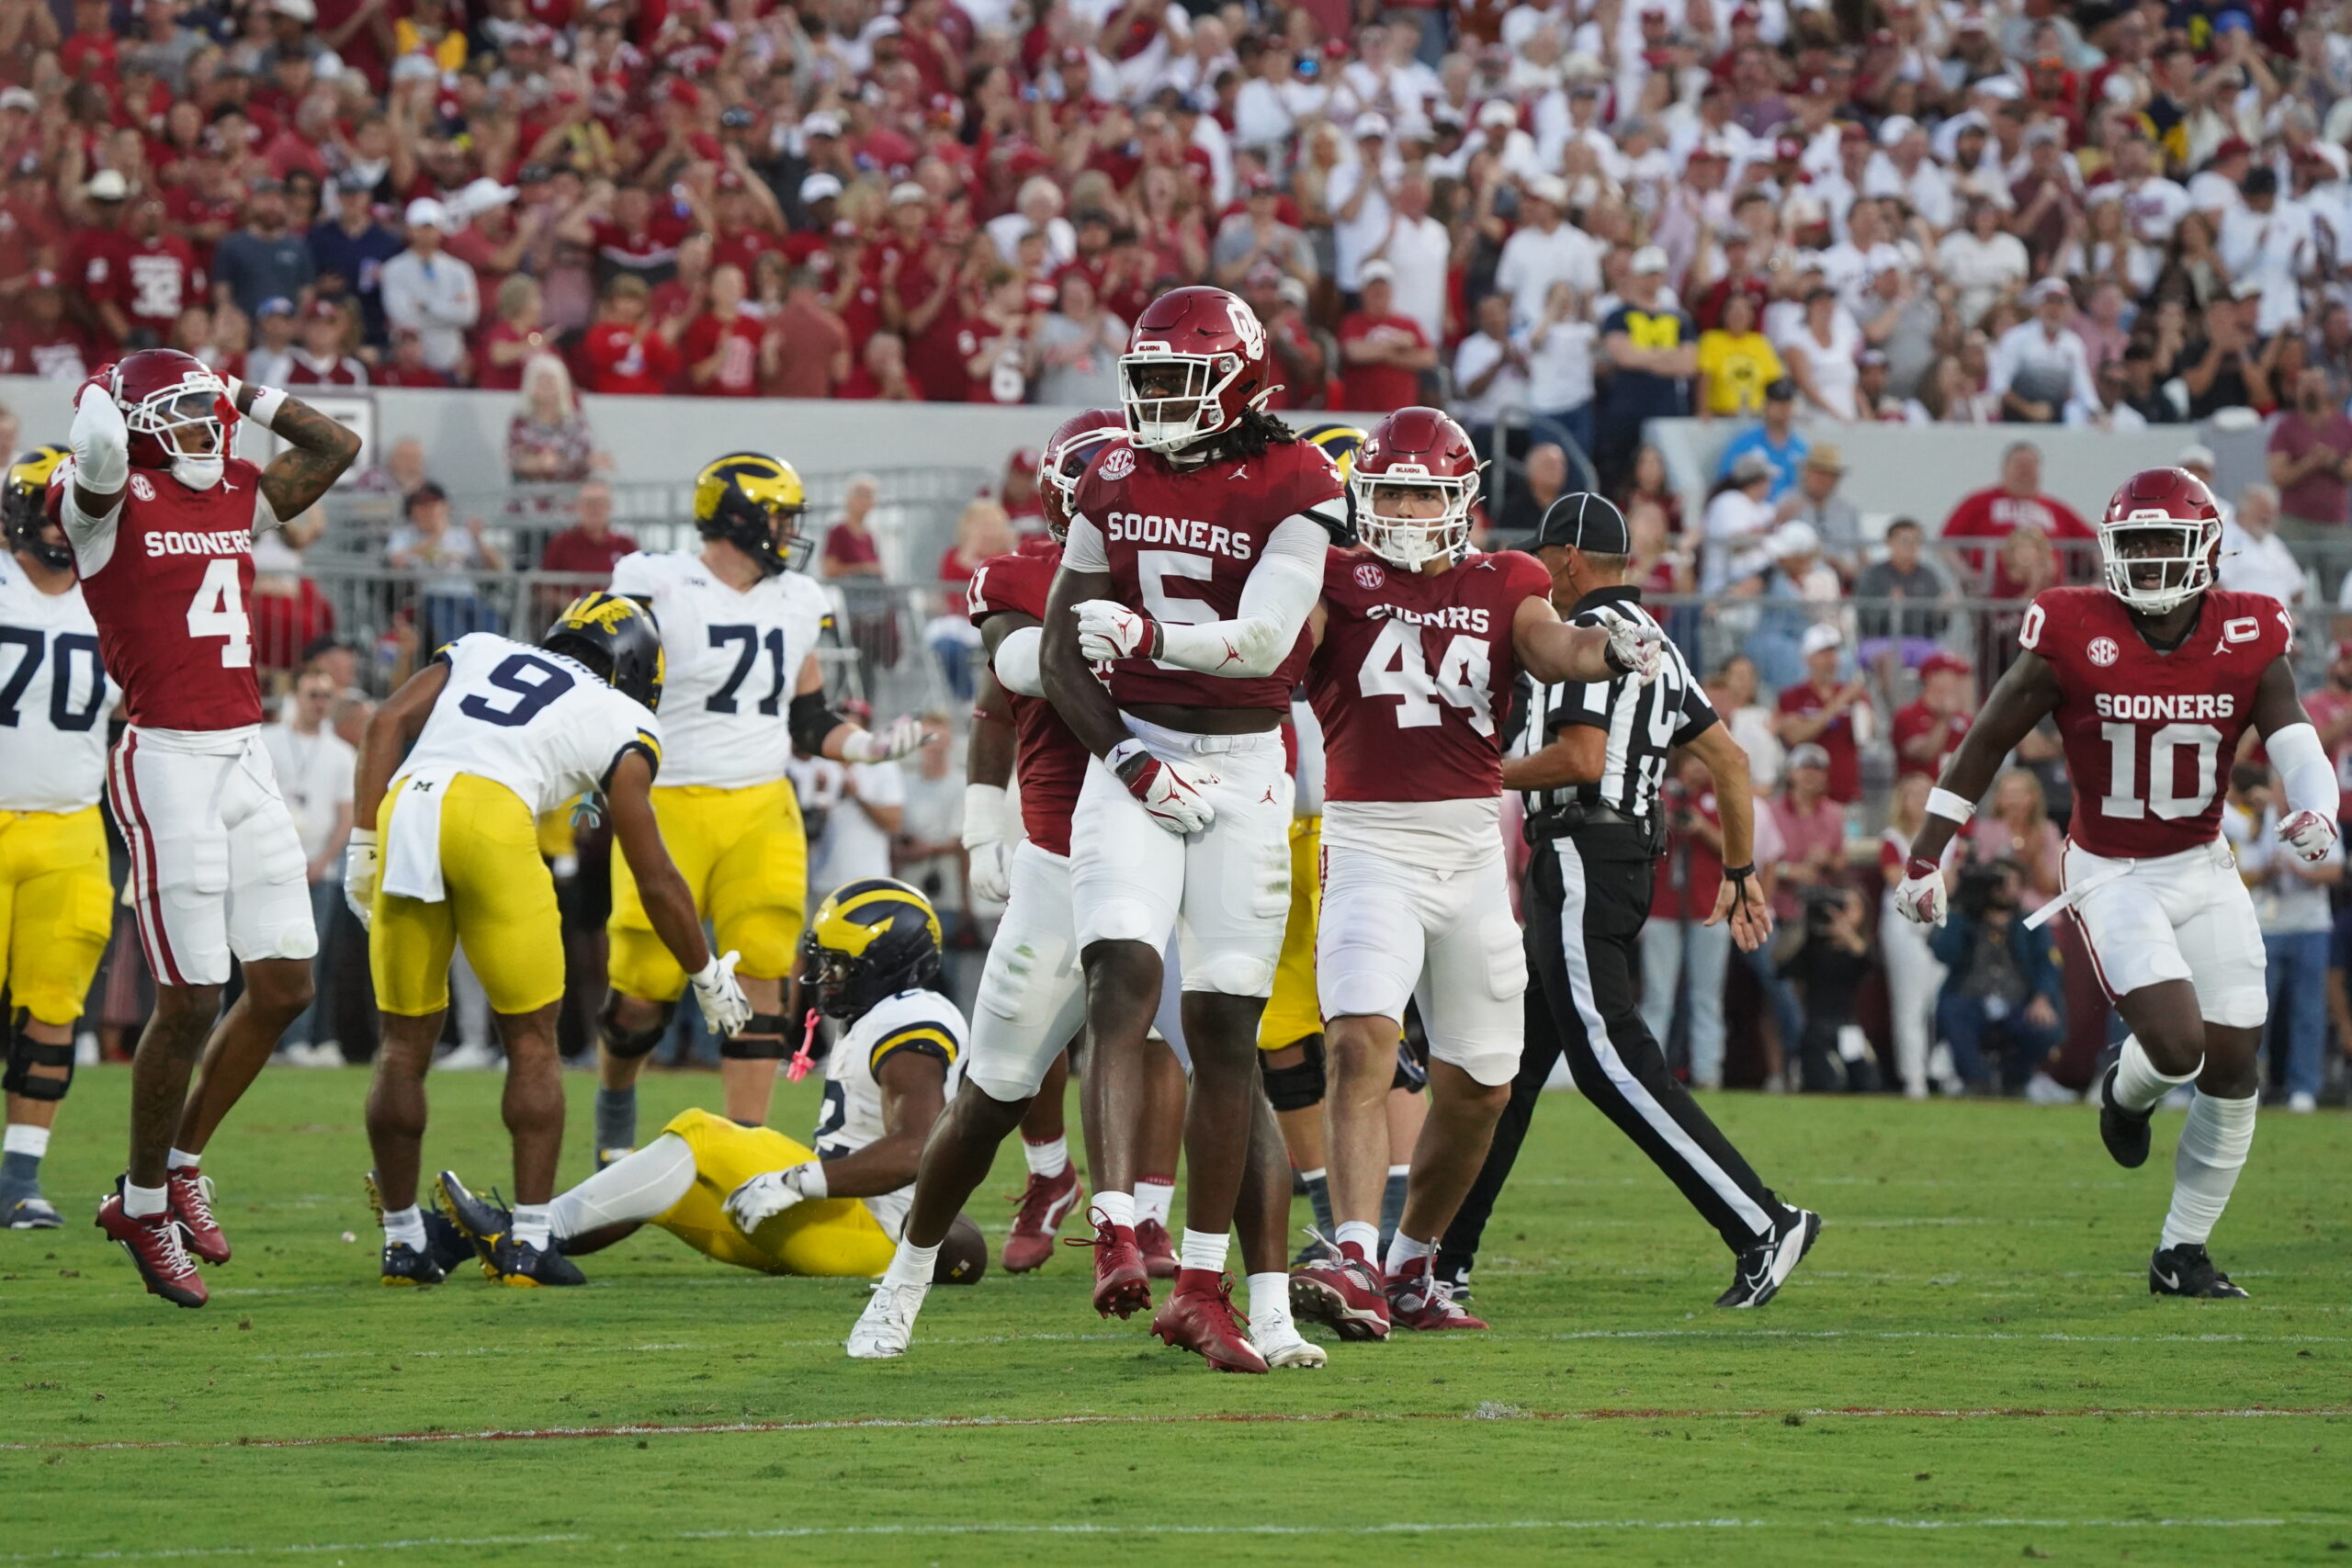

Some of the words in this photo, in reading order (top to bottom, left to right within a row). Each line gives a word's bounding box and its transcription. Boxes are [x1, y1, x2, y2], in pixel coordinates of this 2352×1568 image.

[1105, 449, 1133, 472] SEC
[131, 475, 154, 499] SEC
[144, 529, 252, 558] SOONERS
[1108, 512, 1251, 559] SOONERS
[1355, 567, 1382, 589] SEC
[187, 558, 252, 669] 4
[1137, 550, 1220, 671] 5
[2226, 617, 2258, 642] C
[705, 624, 786, 716] 71
[2089, 639, 2118, 663] SEC
[0, 626, 107, 731] 70
[458, 654, 576, 727] 9
[1357, 617, 1496, 738] 44
[2095, 693, 2234, 719] SOONERS
[413, 781, 434, 792] M
[2101, 721, 2223, 820] 10
